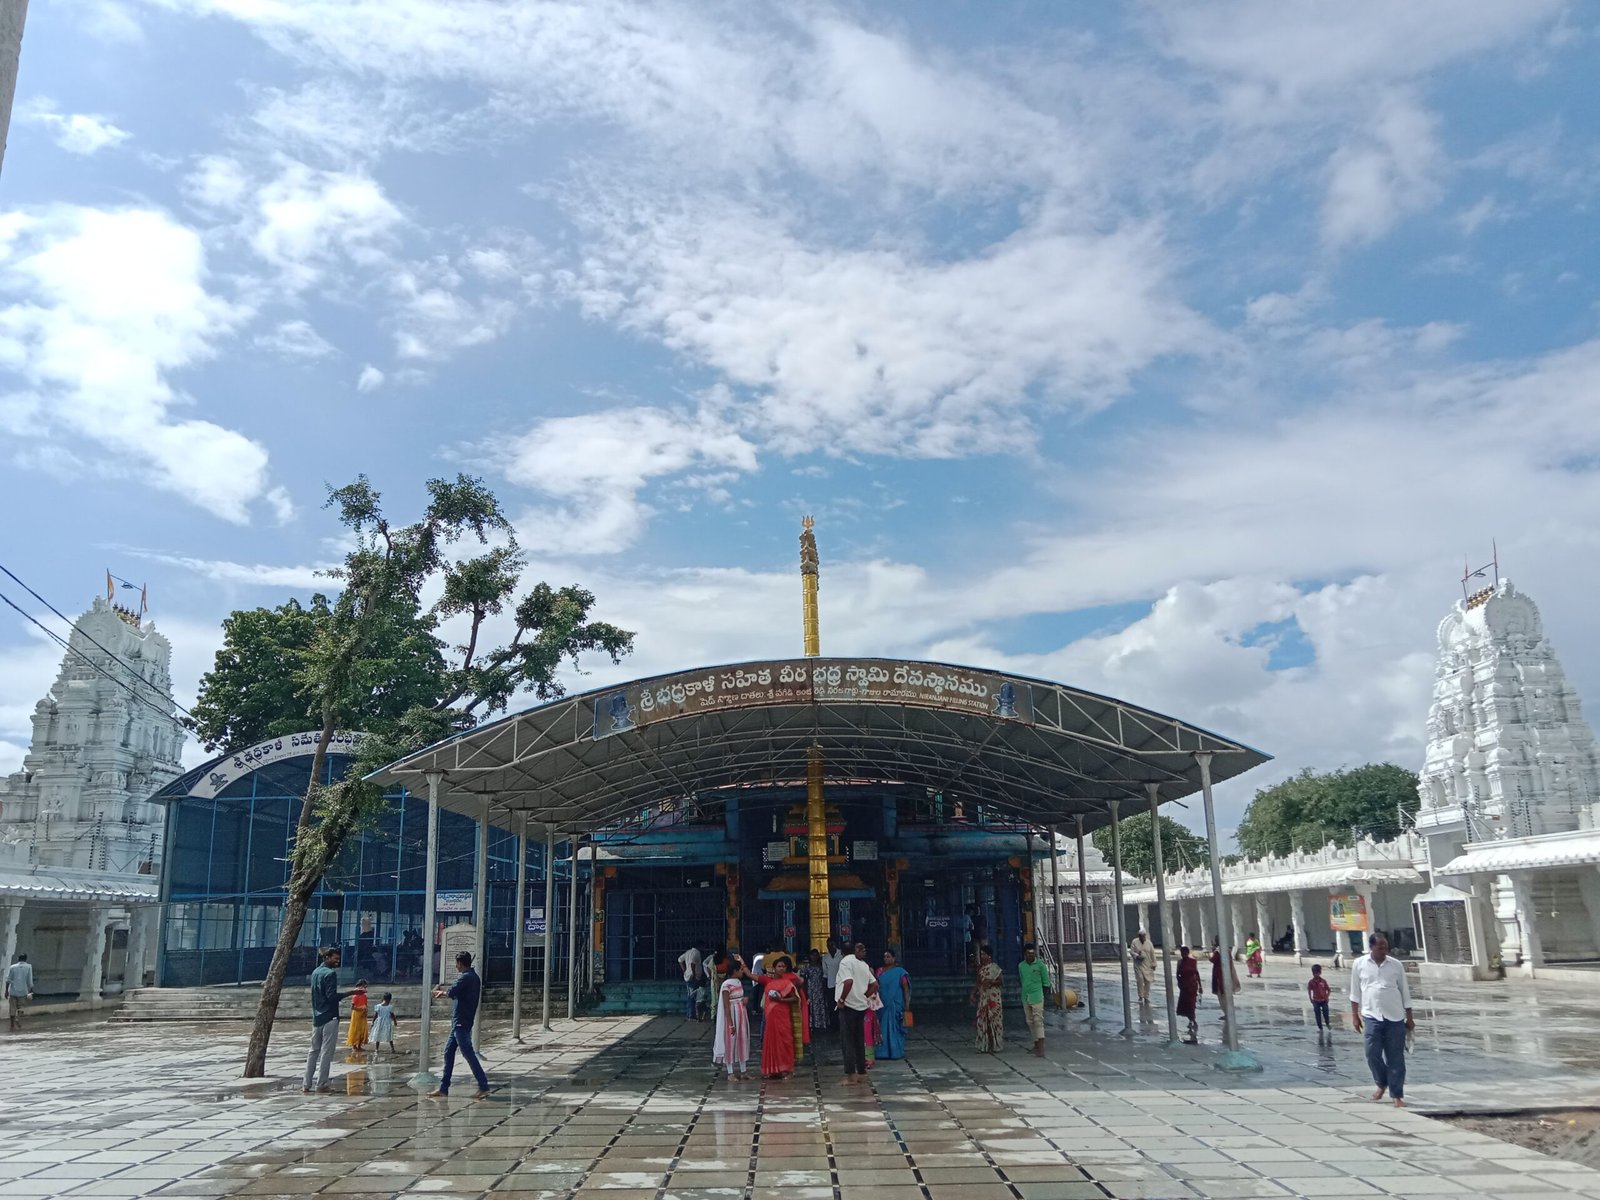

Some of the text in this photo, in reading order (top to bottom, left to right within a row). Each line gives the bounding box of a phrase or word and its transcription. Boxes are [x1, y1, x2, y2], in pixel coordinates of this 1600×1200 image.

[721, 668, 772, 690] సహిత
[845, 665, 890, 687] స్వామి
[893, 664, 988, 697] దేవస్థానము
[968, 700, 989, 710] STATION
